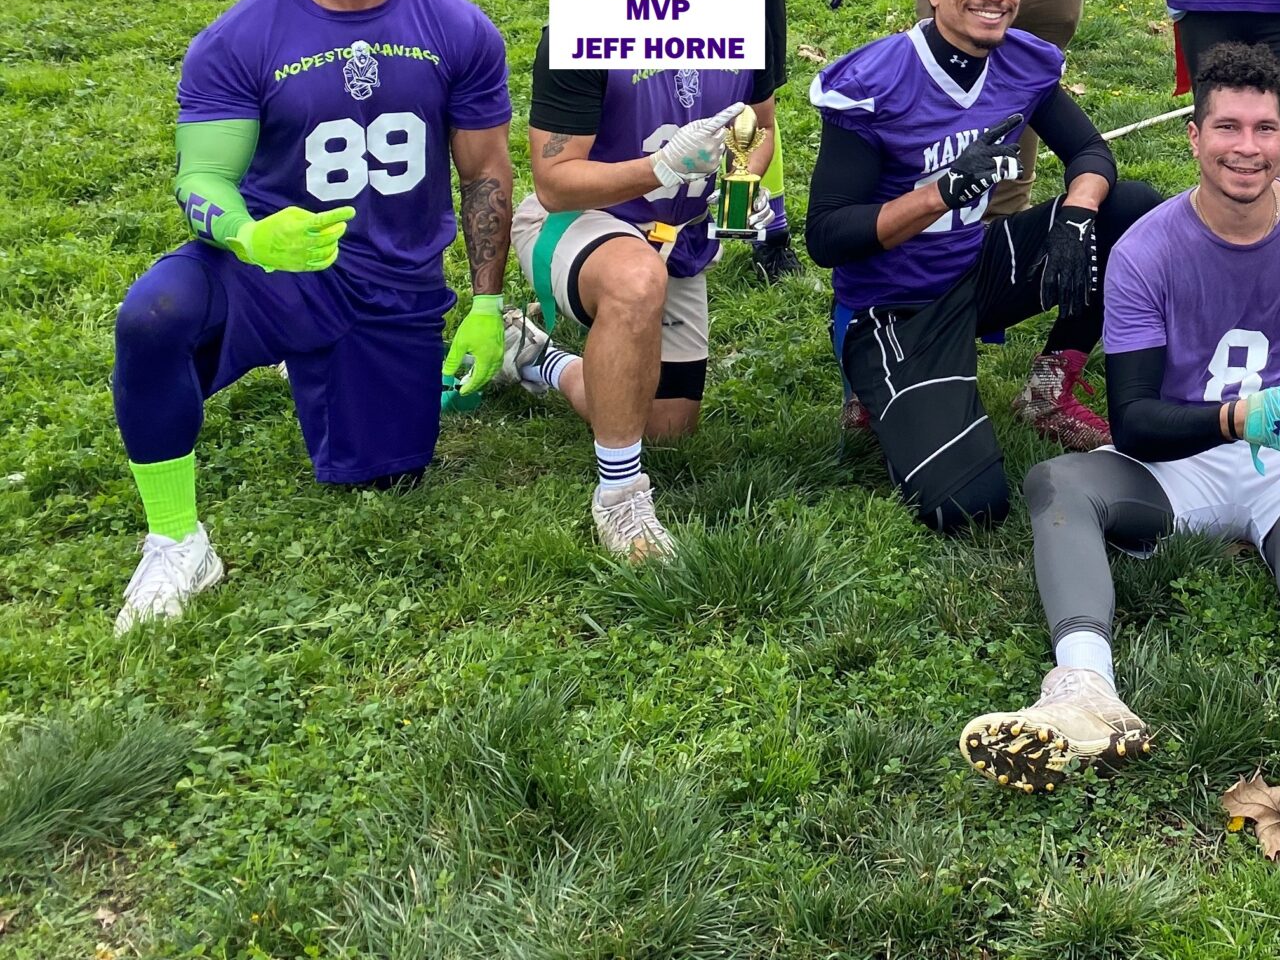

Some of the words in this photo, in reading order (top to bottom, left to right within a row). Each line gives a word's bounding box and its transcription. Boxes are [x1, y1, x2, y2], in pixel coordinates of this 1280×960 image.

[274, 47, 354, 82] MODESTO
[365, 42, 440, 66] MANIACS
[304, 111, 427, 202] 89
[1203, 328, 1270, 402] 8
